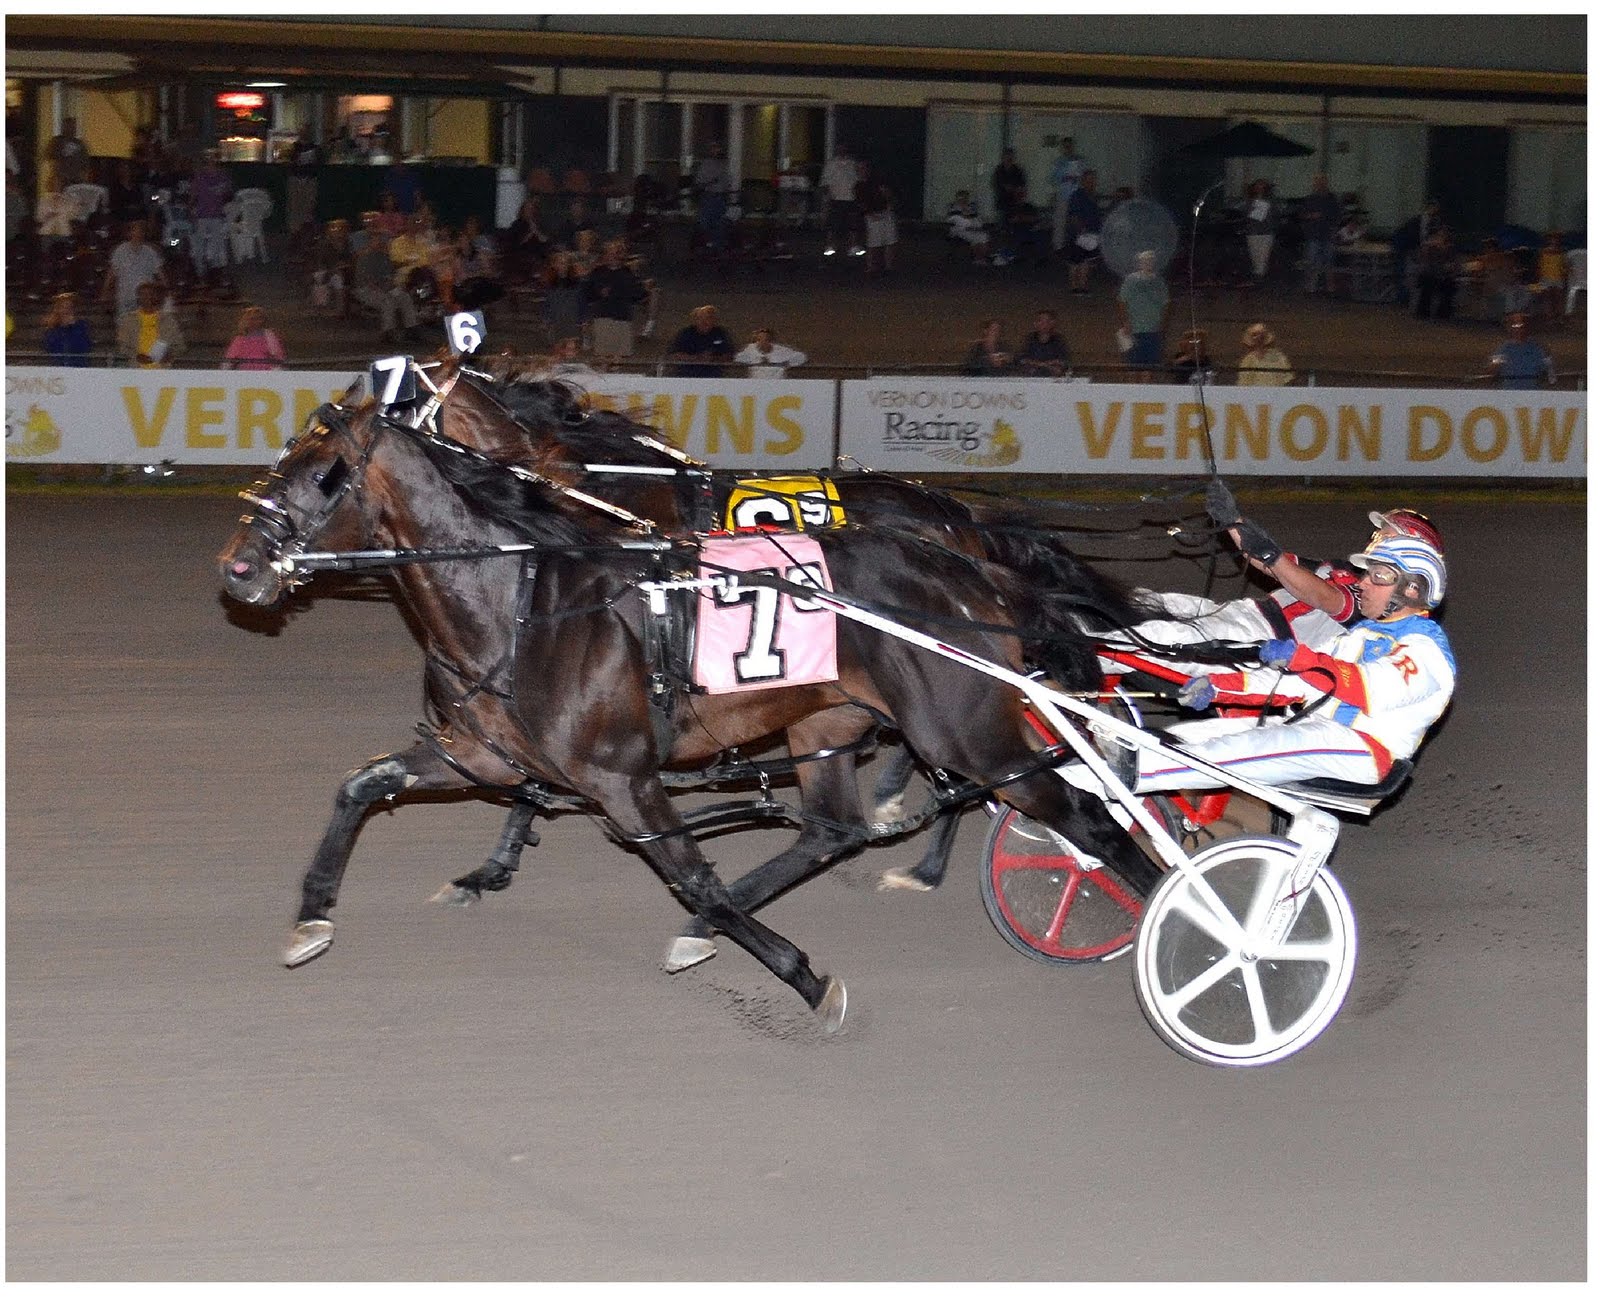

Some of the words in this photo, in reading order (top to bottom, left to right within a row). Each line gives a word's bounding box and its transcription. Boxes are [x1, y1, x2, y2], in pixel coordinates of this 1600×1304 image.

[451, 312, 482, 353] 6
[375, 356, 407, 405] 7
[120, 386, 348, 449] VERN
[582, 392, 804, 456] WNS
[882, 412, 981, 451] Racing
[1075, 402, 1382, 462] VERNON
[1407, 405, 1587, 463] DOW
[711, 567, 787, 684] 7
